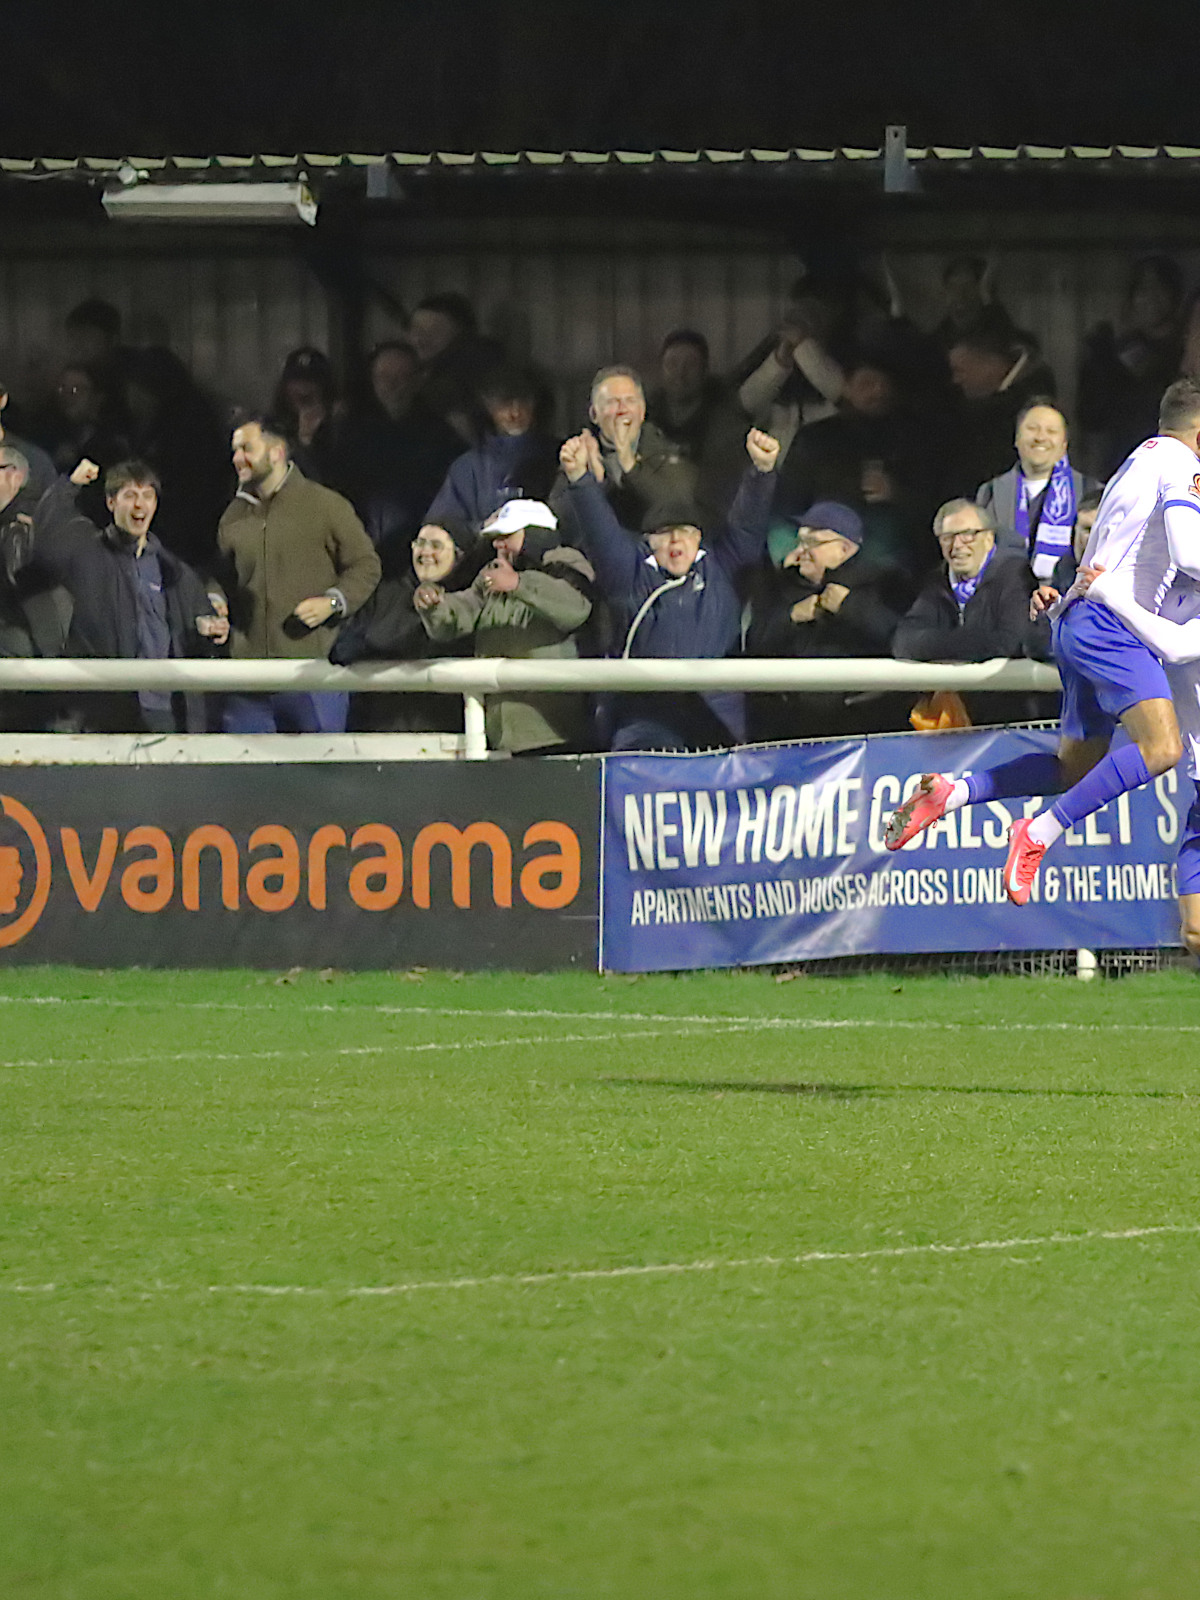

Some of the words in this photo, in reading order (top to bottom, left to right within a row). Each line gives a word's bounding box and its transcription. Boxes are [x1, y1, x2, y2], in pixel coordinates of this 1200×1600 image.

[60, 820, 581, 913] vanarama
[625, 789, 727, 871] NEW
[736, 778, 862, 864] HOME
[631, 883, 751, 926] APARTMENTS
[755, 880, 796, 918] AND
[799, 873, 867, 914] HOUSES
[868, 867, 949, 907] ACROSS
[953, 866, 1040, 904] LONDN
[1044, 866, 1061, 903] &
[1062, 864, 1102, 902] THE
[1107, 863, 1171, 901] HOME
